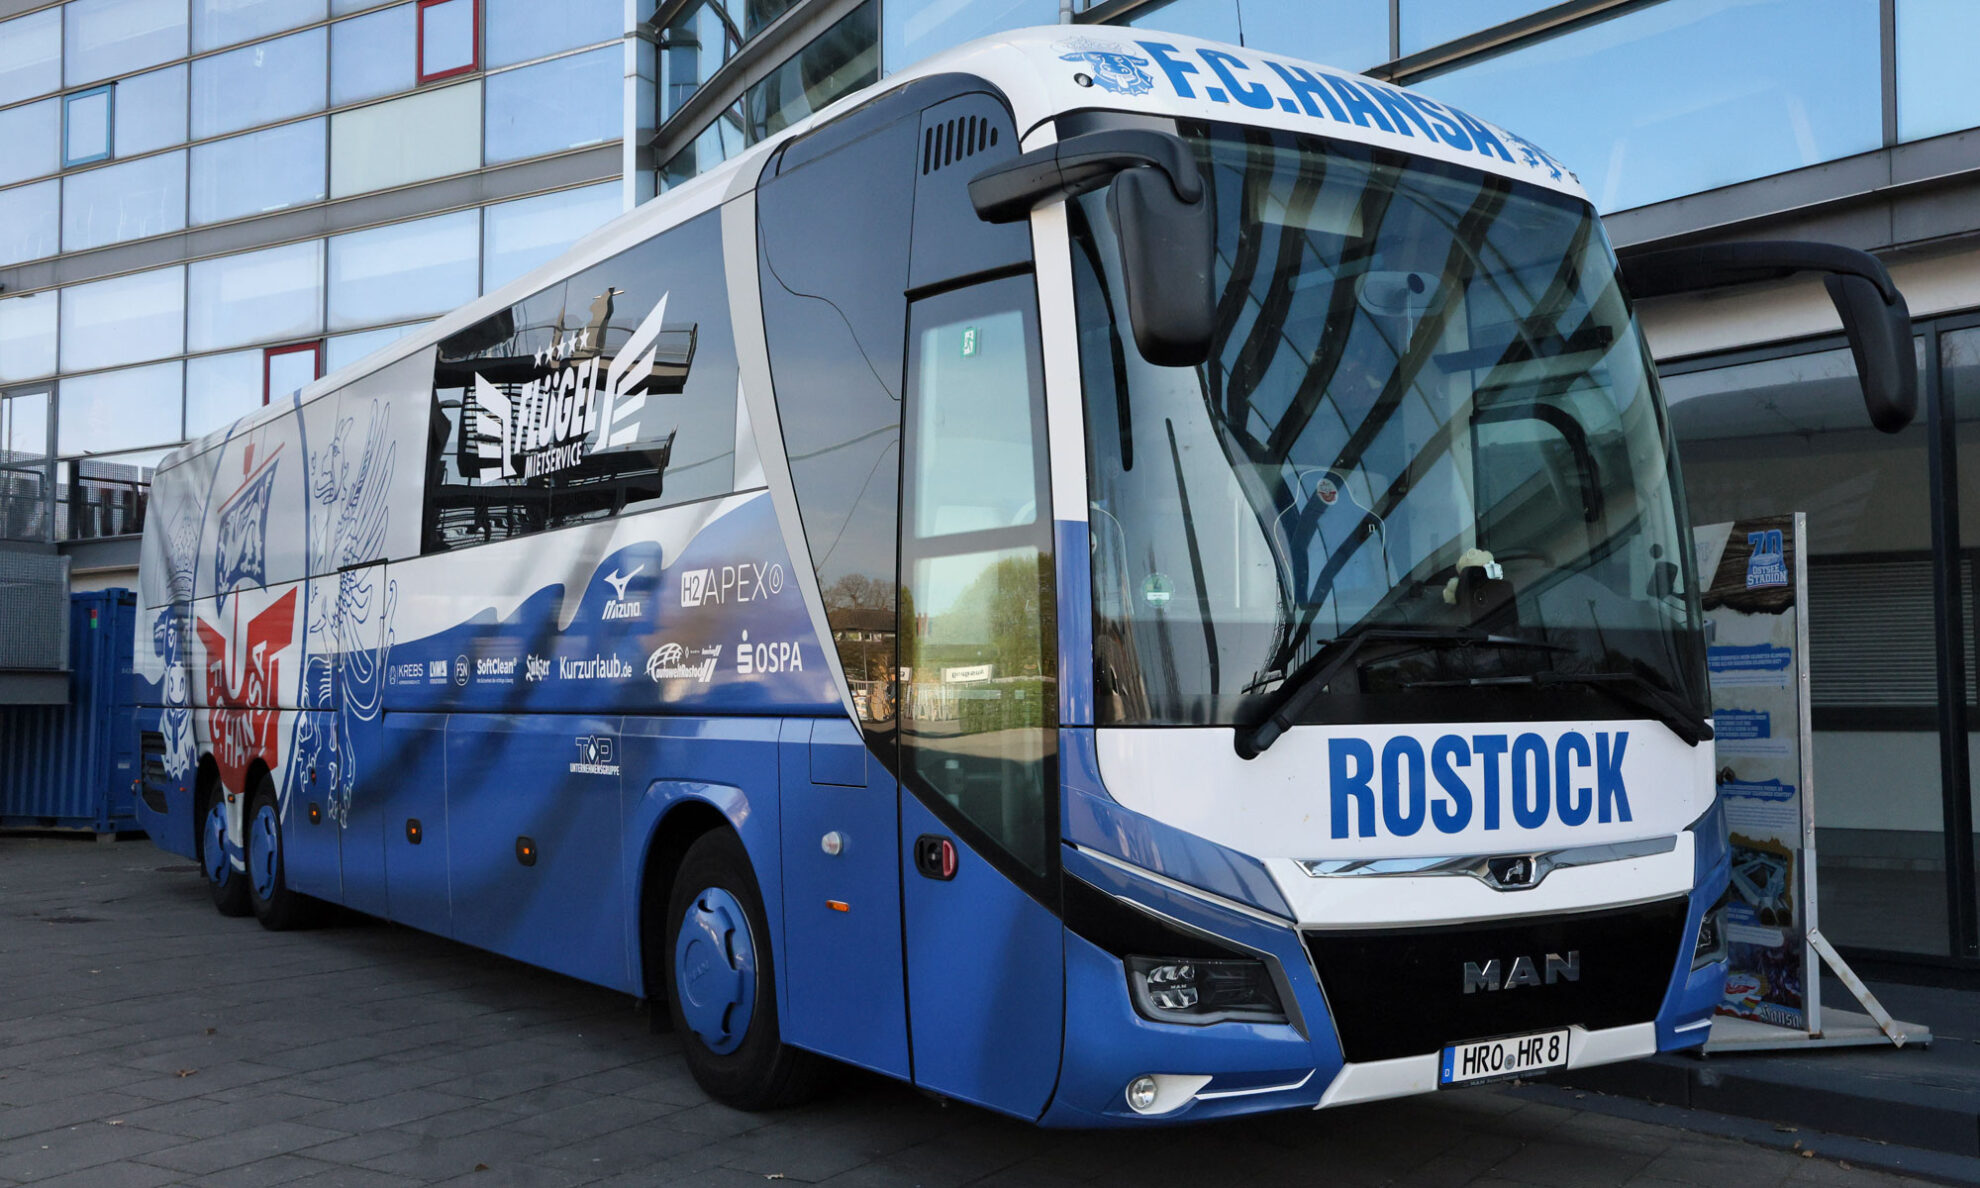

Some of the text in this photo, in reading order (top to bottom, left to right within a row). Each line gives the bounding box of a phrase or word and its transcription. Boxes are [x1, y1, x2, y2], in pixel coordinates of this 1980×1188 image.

[525, 442, 583, 480] MIETSERVICE
[1747, 571, 1788, 586] STADION
[398, 664, 424, 677] KREBS
[559, 652, 632, 680] Kurzurlaub.de
[756, 641, 803, 673] OSPA
[1328, 731, 1633, 839] ROSTOCK
[1463, 951, 1580, 994] MAN
[1462, 1035, 1560, 1076] HRO HR 8
